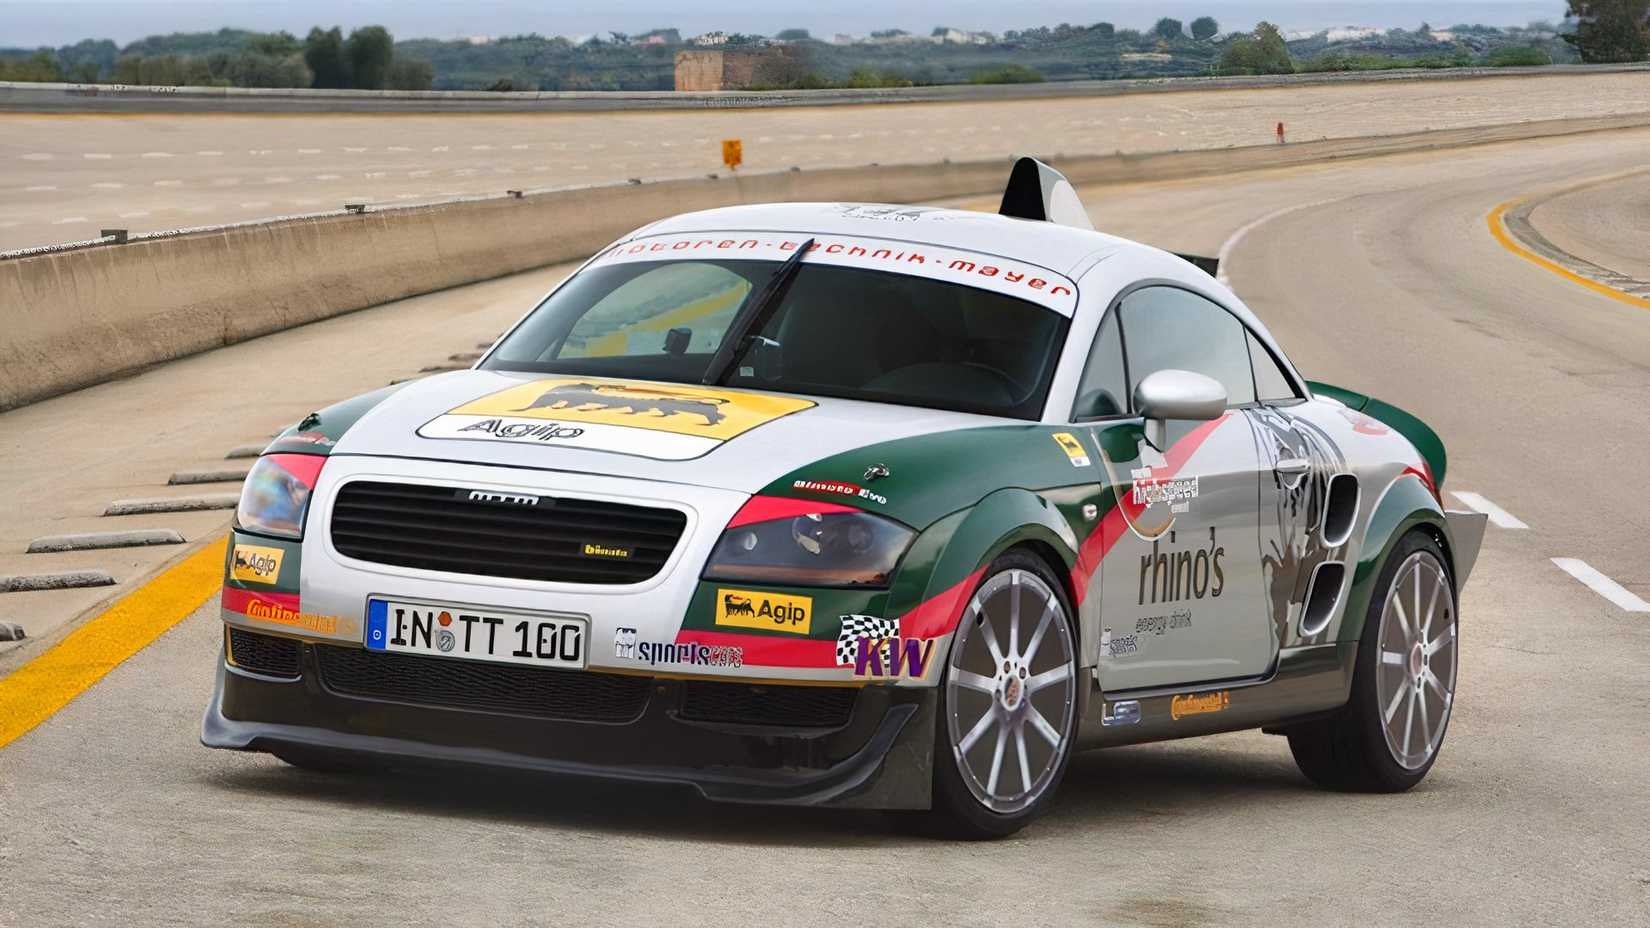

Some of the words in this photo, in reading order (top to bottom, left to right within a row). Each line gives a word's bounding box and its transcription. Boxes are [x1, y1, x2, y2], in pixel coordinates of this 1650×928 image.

[457, 418, 584, 442] Agip
[249, 553, 278, 577] Agip
[1138, 526, 1225, 605] rhino's
[757, 599, 805, 625] Agip
[390, 608, 434, 649] IN
[459, 614, 504, 655] TT
[512, 621, 581, 661] 100
[854, 635, 938, 679] KW
